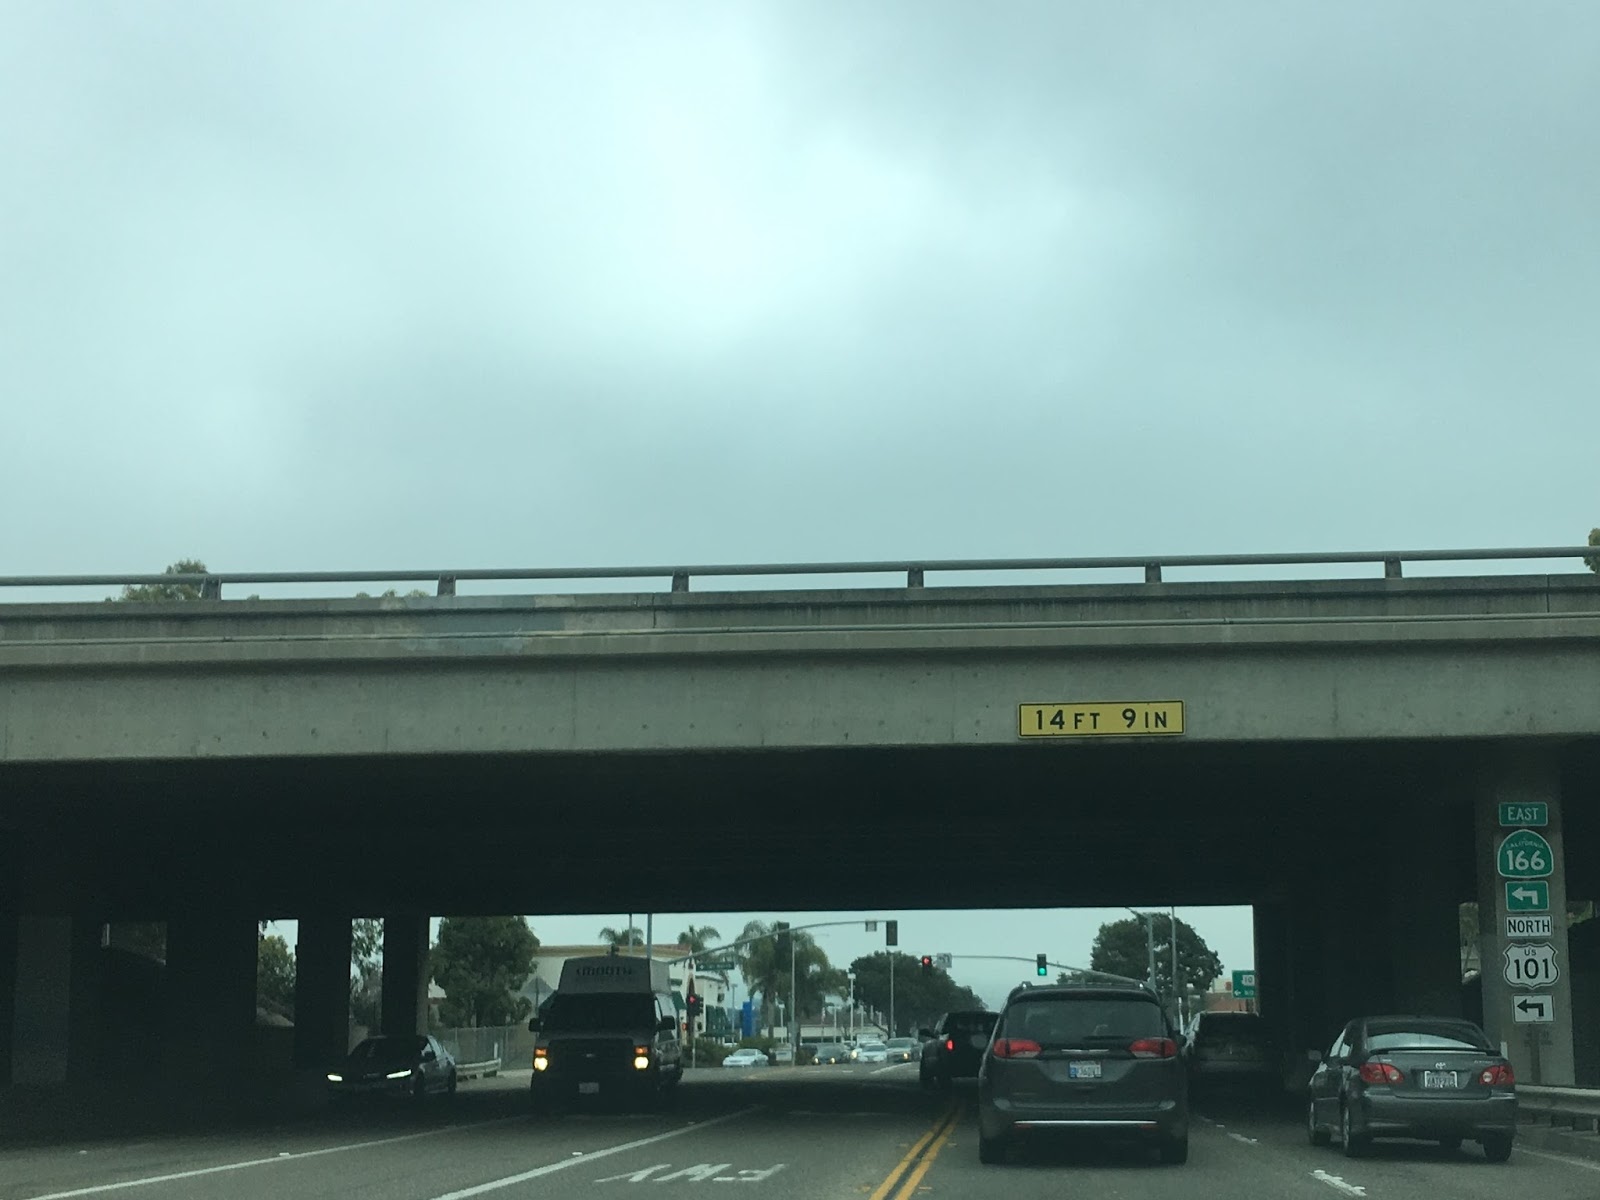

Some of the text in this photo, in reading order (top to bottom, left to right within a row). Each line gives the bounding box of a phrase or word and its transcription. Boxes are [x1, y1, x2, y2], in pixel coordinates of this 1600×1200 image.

[1507, 806, 1539, 821] EAST
[1506, 850, 1545, 871] 166
[1508, 919, 1550, 933] NORTH
[1514, 958, 1549, 979] 101
